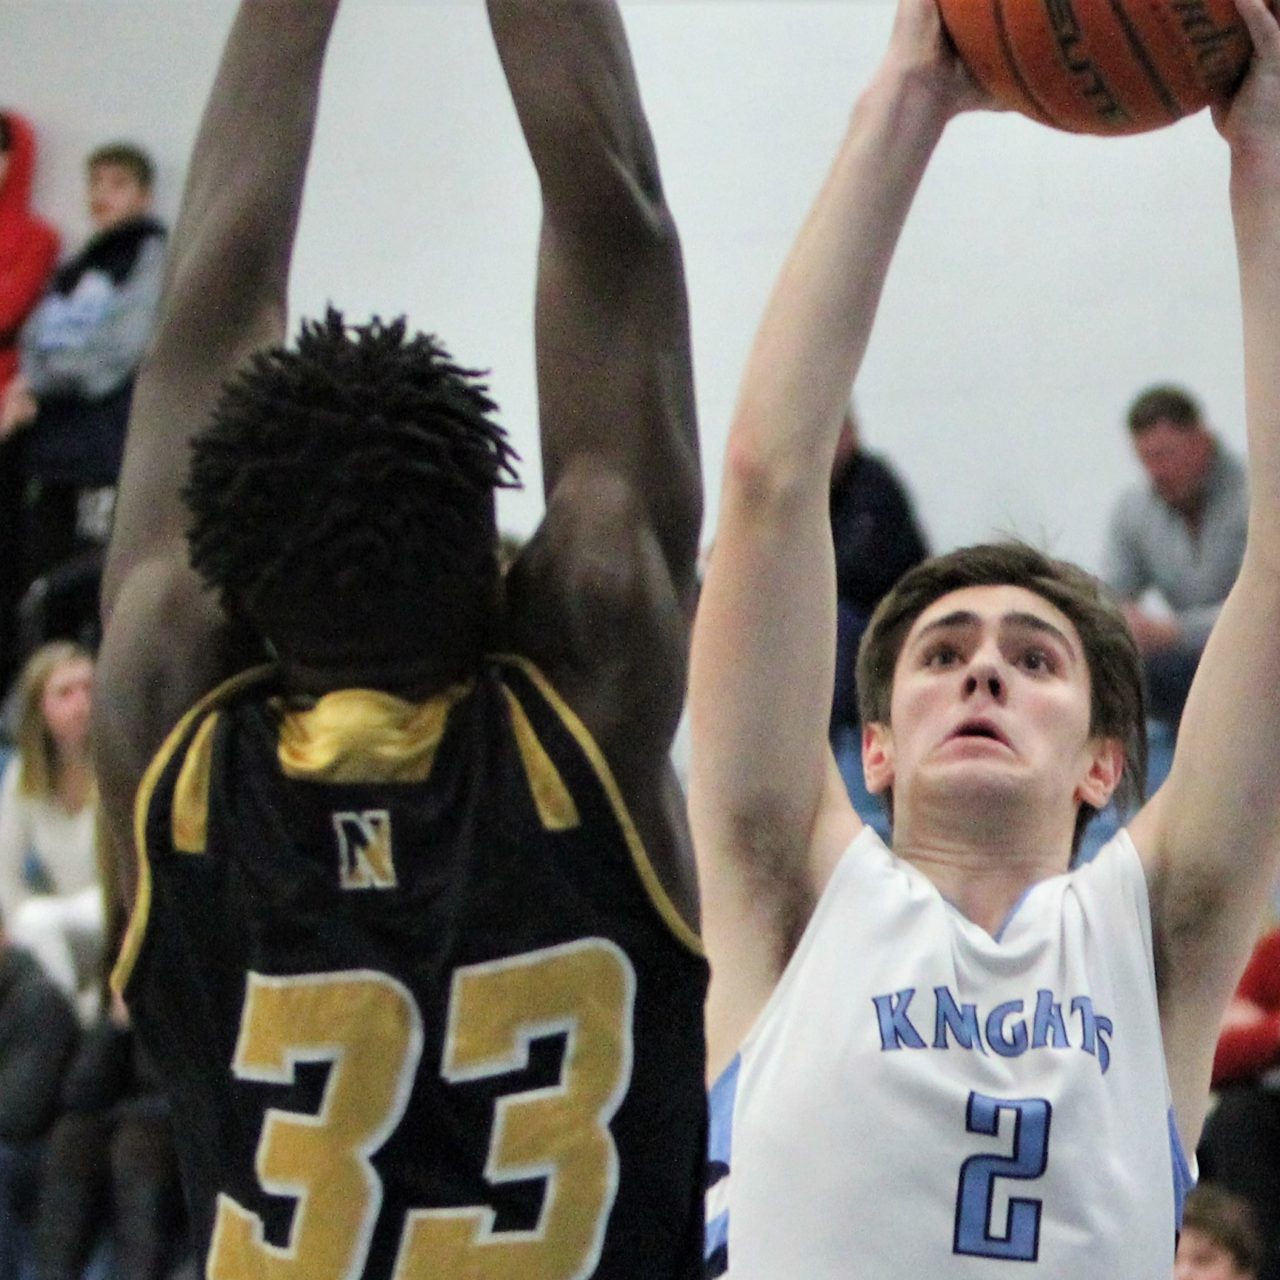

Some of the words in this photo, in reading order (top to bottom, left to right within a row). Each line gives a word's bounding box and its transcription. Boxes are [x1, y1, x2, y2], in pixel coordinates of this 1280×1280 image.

[333, 809, 397, 890] N
[871, 985, 1114, 1076] KNGHTS
[952, 1090, 1053, 1263] 2
